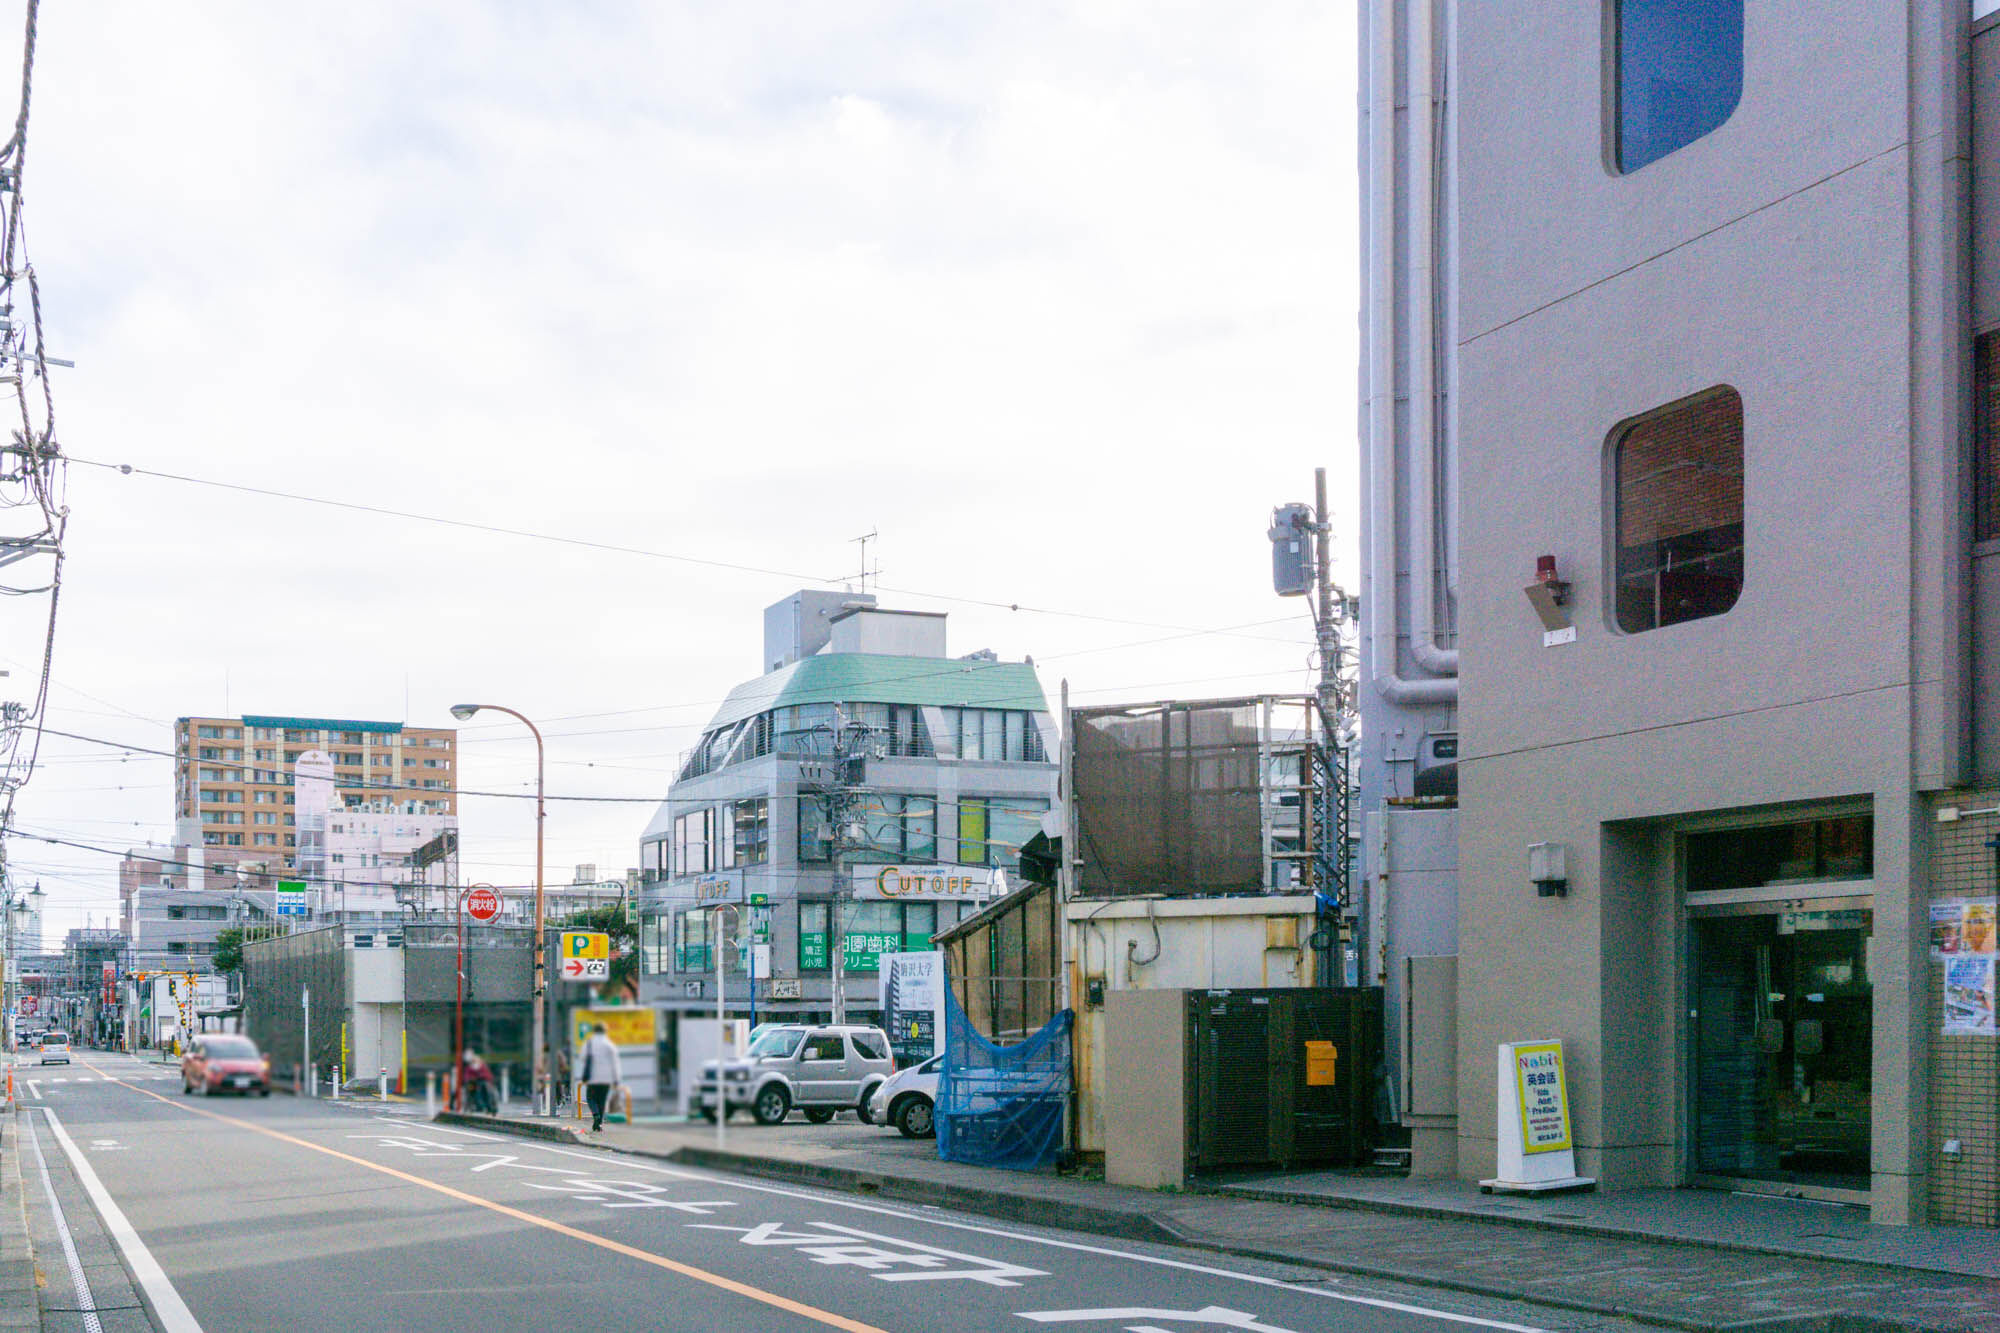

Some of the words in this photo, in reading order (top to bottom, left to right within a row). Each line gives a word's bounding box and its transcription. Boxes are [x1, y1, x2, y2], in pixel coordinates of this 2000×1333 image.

[470, 898, 496, 911] 消火栓
[572, 935, 589, 956] P
[804, 934, 823, 945] 一般
[804, 957, 823, 968] 小児
[1527, 1071, 1557, 1086] 英会話
